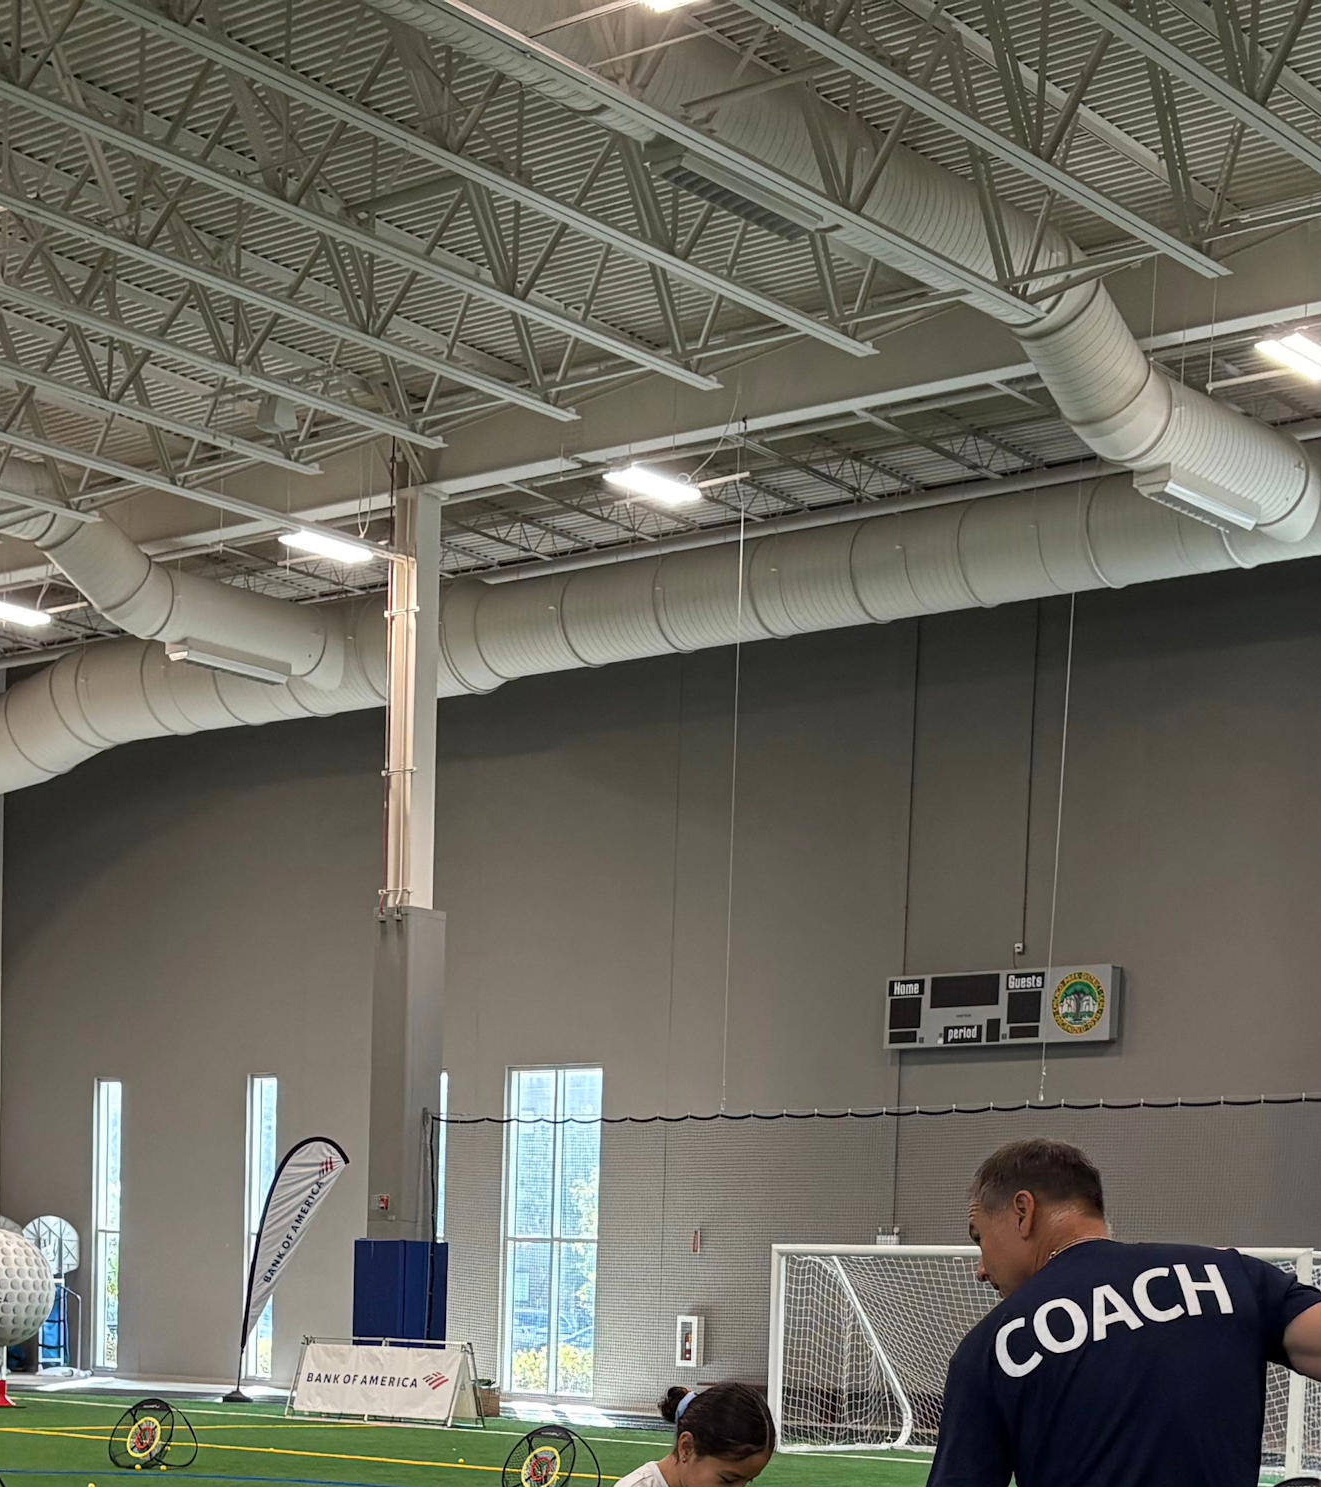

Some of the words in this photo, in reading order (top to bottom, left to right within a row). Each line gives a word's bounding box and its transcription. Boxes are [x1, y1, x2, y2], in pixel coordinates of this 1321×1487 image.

[893, 982, 920, 996] Home
[1008, 975, 1042, 989] Guests
[947, 1025, 978, 1042] period
[263, 1251, 286, 1283] BANK
[281, 1233, 294, 1249] OF
[290, 1180, 325, 1233] AMERICA
[995, 1263, 1235, 1379] COACH
[306, 1372, 340, 1384] BANK
[342, 1374, 359, 1385] OF
[360, 1375, 418, 1389] AMERICA
